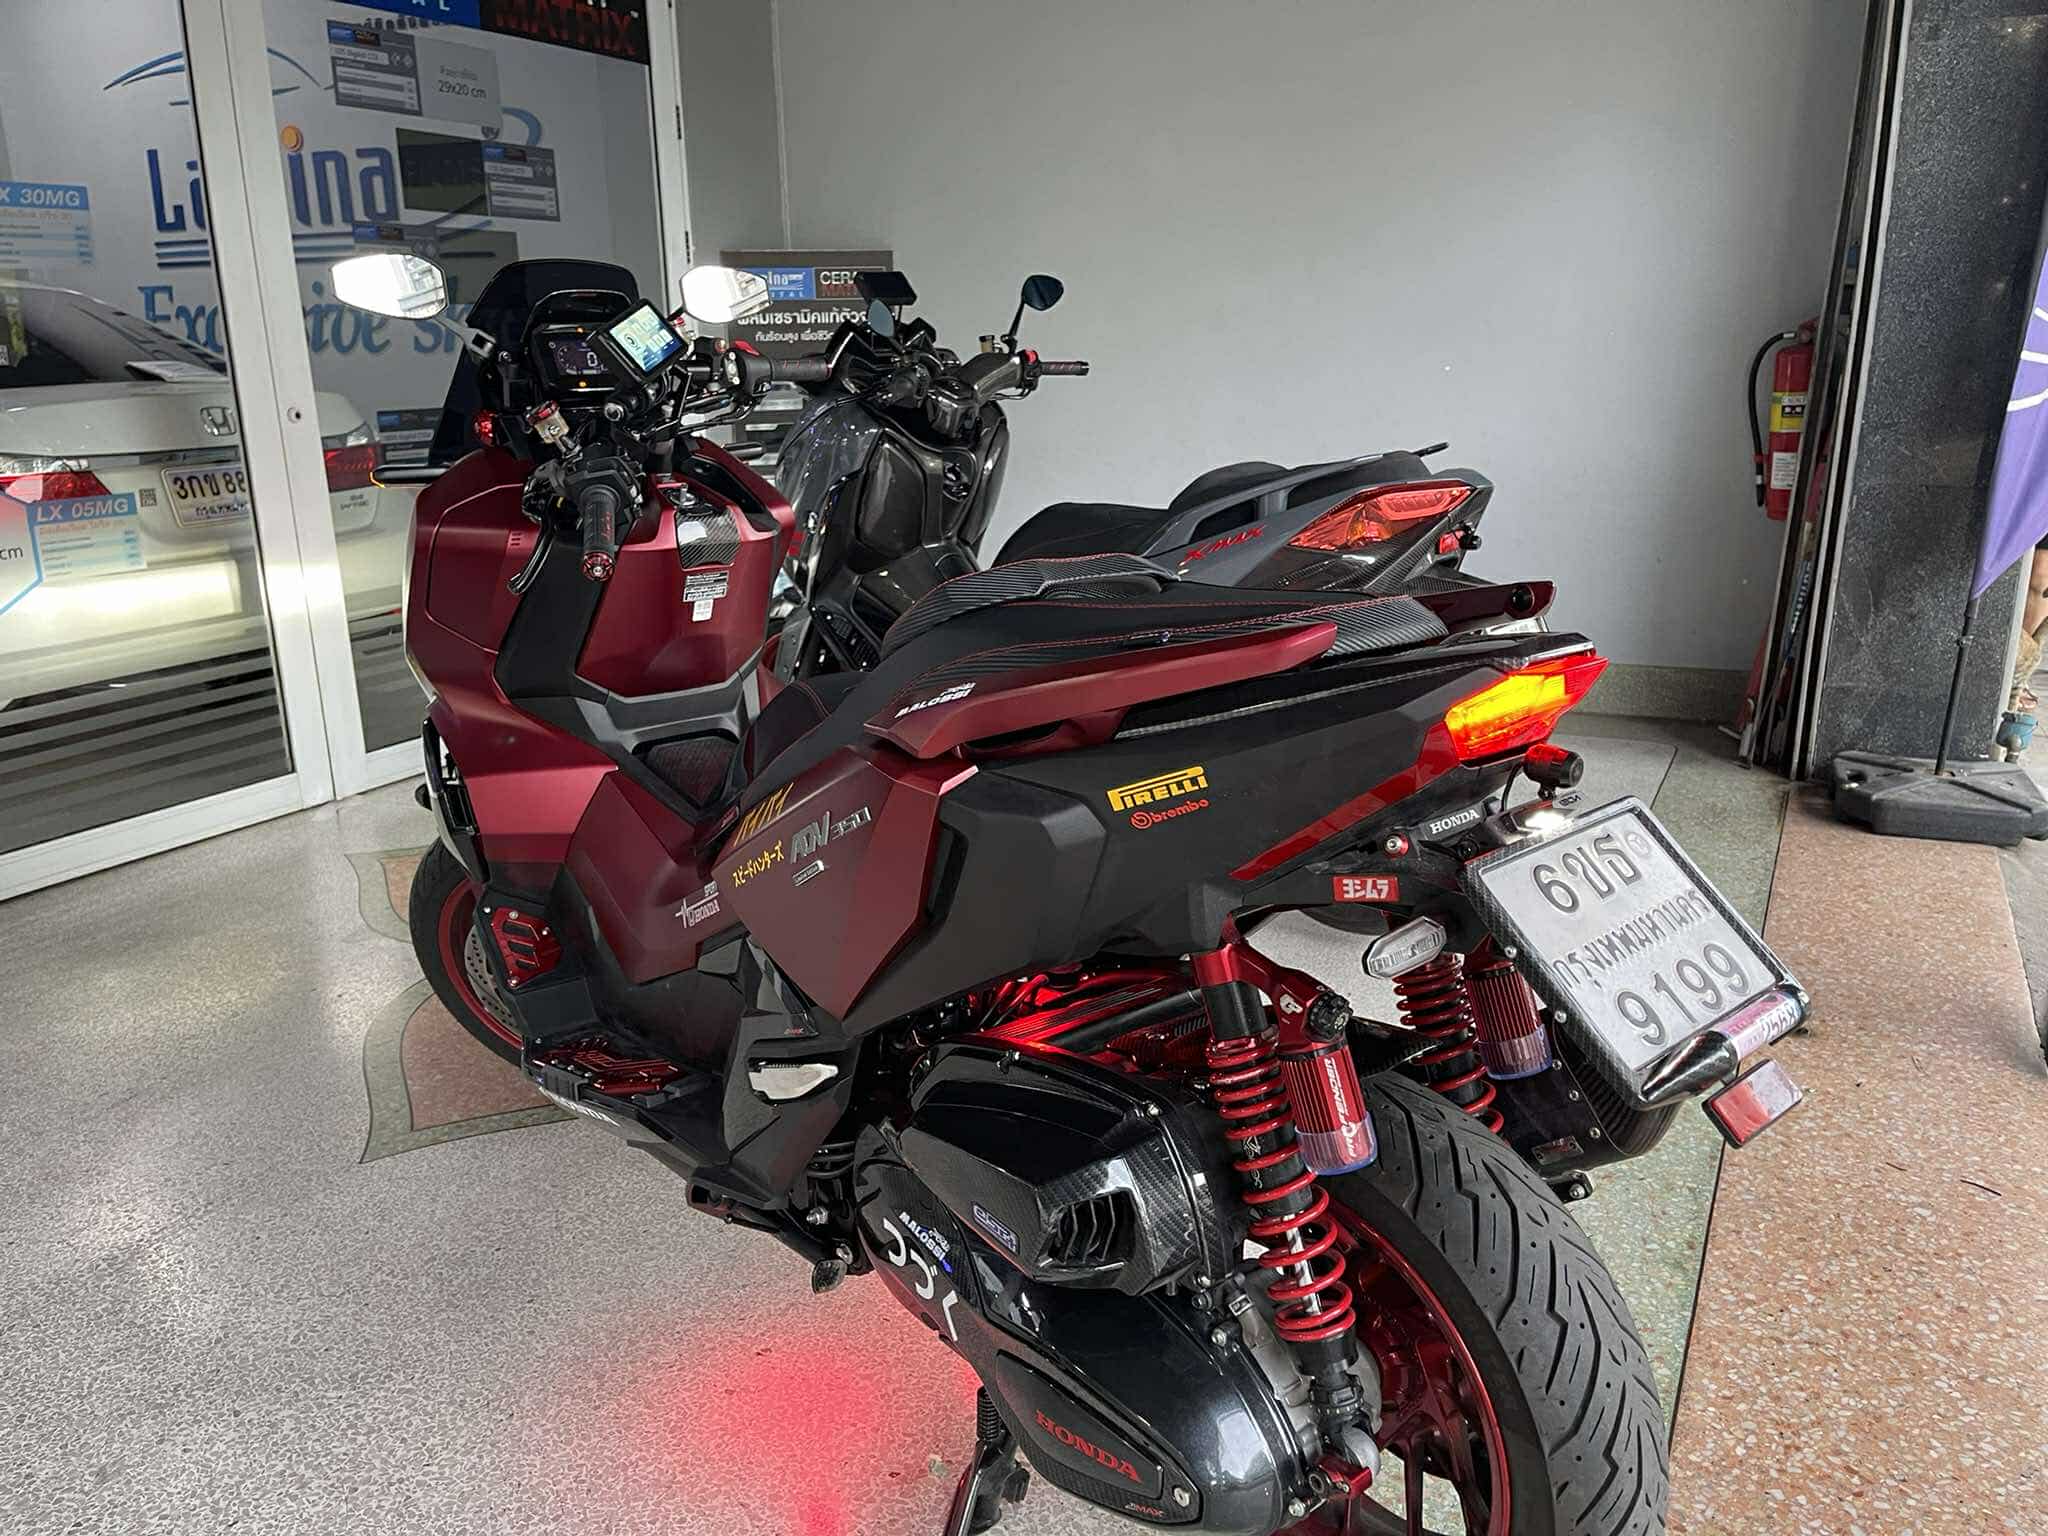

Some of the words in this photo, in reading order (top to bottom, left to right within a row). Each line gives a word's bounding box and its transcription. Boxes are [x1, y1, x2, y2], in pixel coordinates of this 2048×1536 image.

[20, 188, 81, 207] 30MG
[37, 504, 63, 522] LX
[71, 498, 129, 518] 05MG
[1106, 765, 1209, 812] PIRELLI
[1152, 798, 1210, 824] brembo
[1428, 808, 1481, 835] HONDA
[731, 839, 785, 888] スピードハンターズ
[1342, 878, 1390, 899] ヨシムラ
[1552, 889, 1713, 991] กรุงเทพมหานคร
[1616, 943, 1750, 1046] 9199
[899, 1211, 947, 1261] MALOSSI
[1035, 1408, 1143, 1485] HONDA
